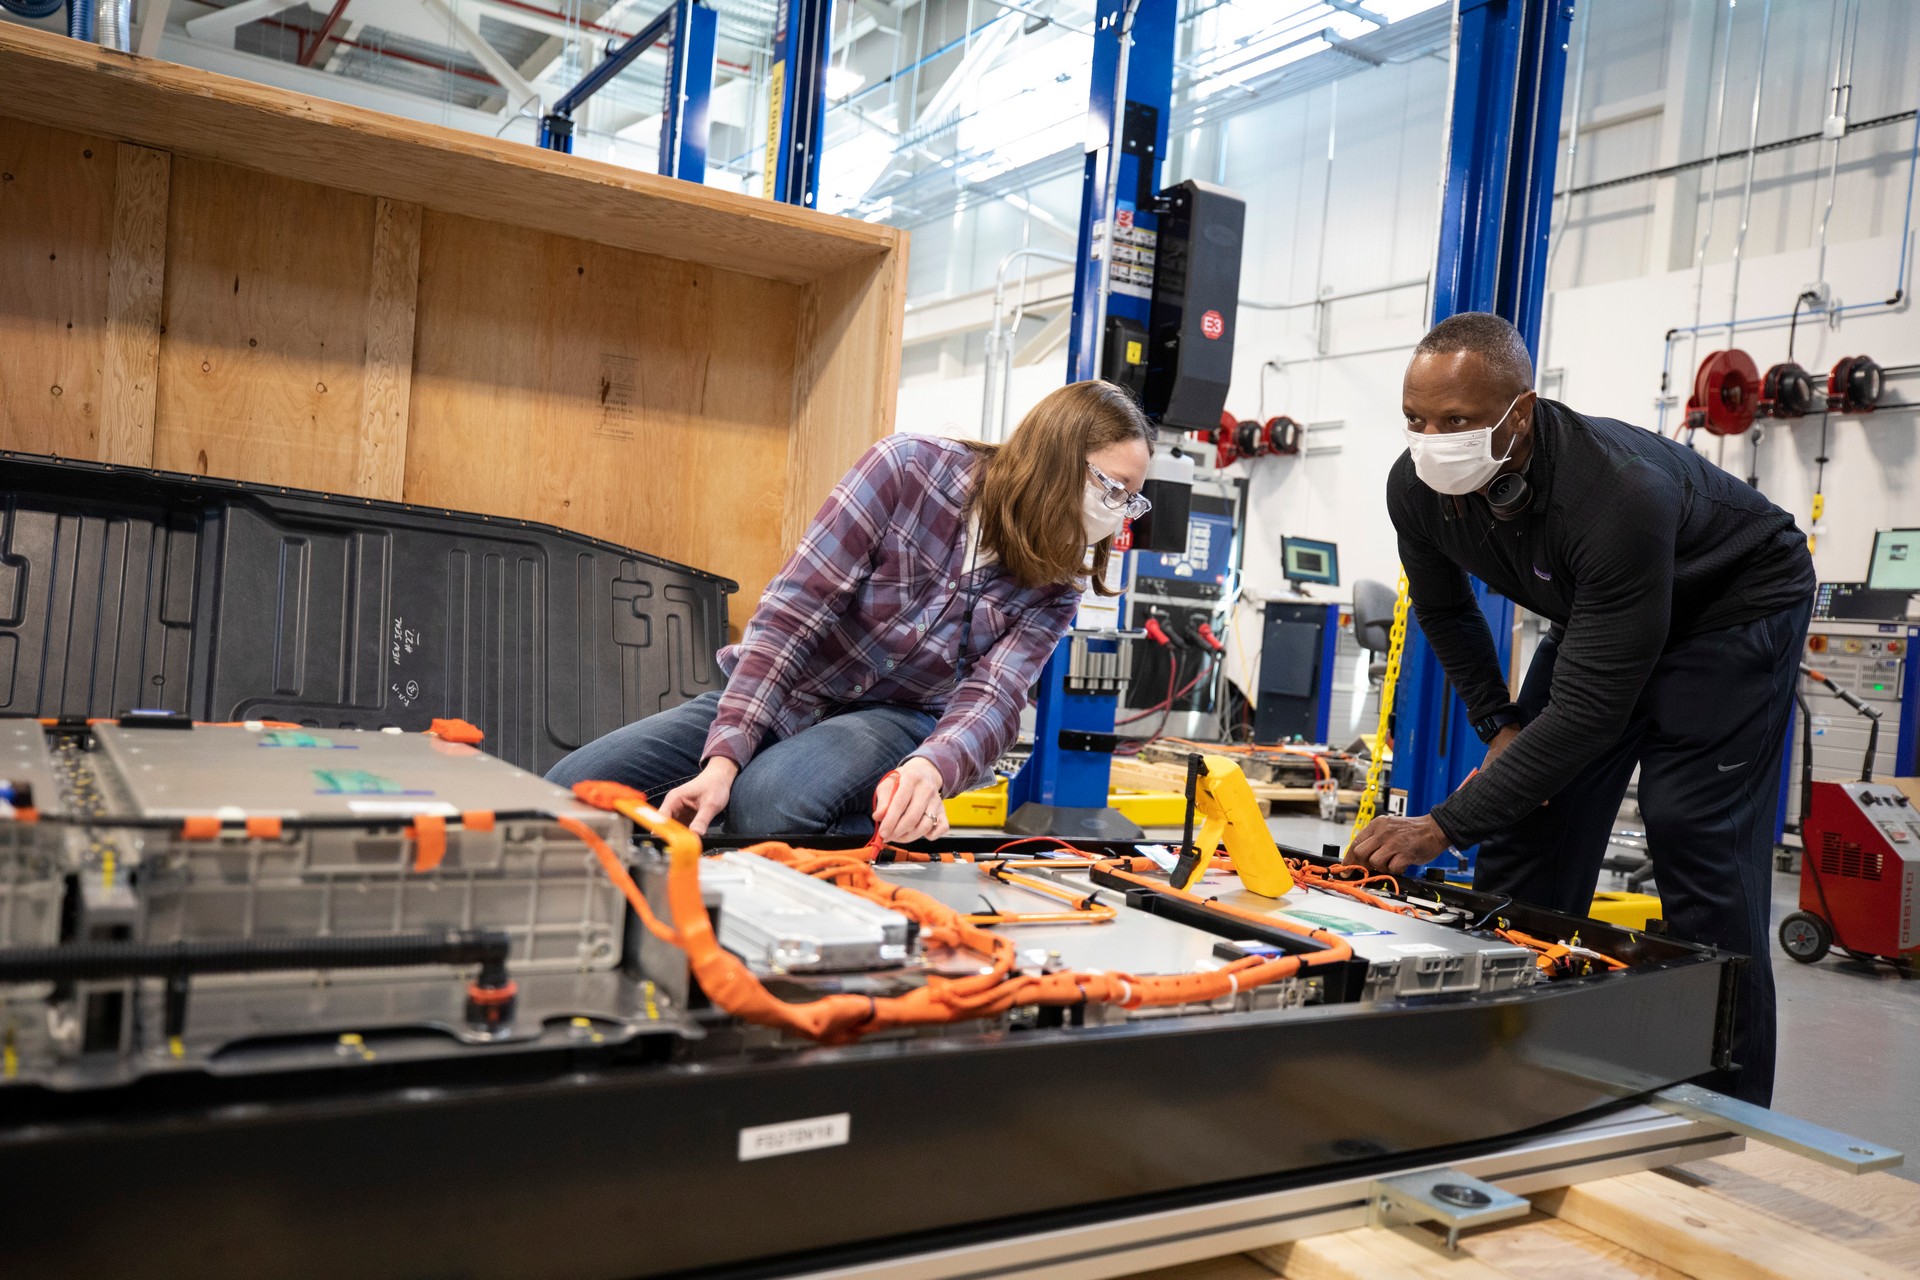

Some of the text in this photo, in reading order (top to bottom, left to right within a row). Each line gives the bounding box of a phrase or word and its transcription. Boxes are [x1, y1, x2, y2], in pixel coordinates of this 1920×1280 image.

[1118, 210, 1133, 223] E2
[1203, 316, 1223, 333] E3
[392, 616, 403, 666] NEW SEAL
